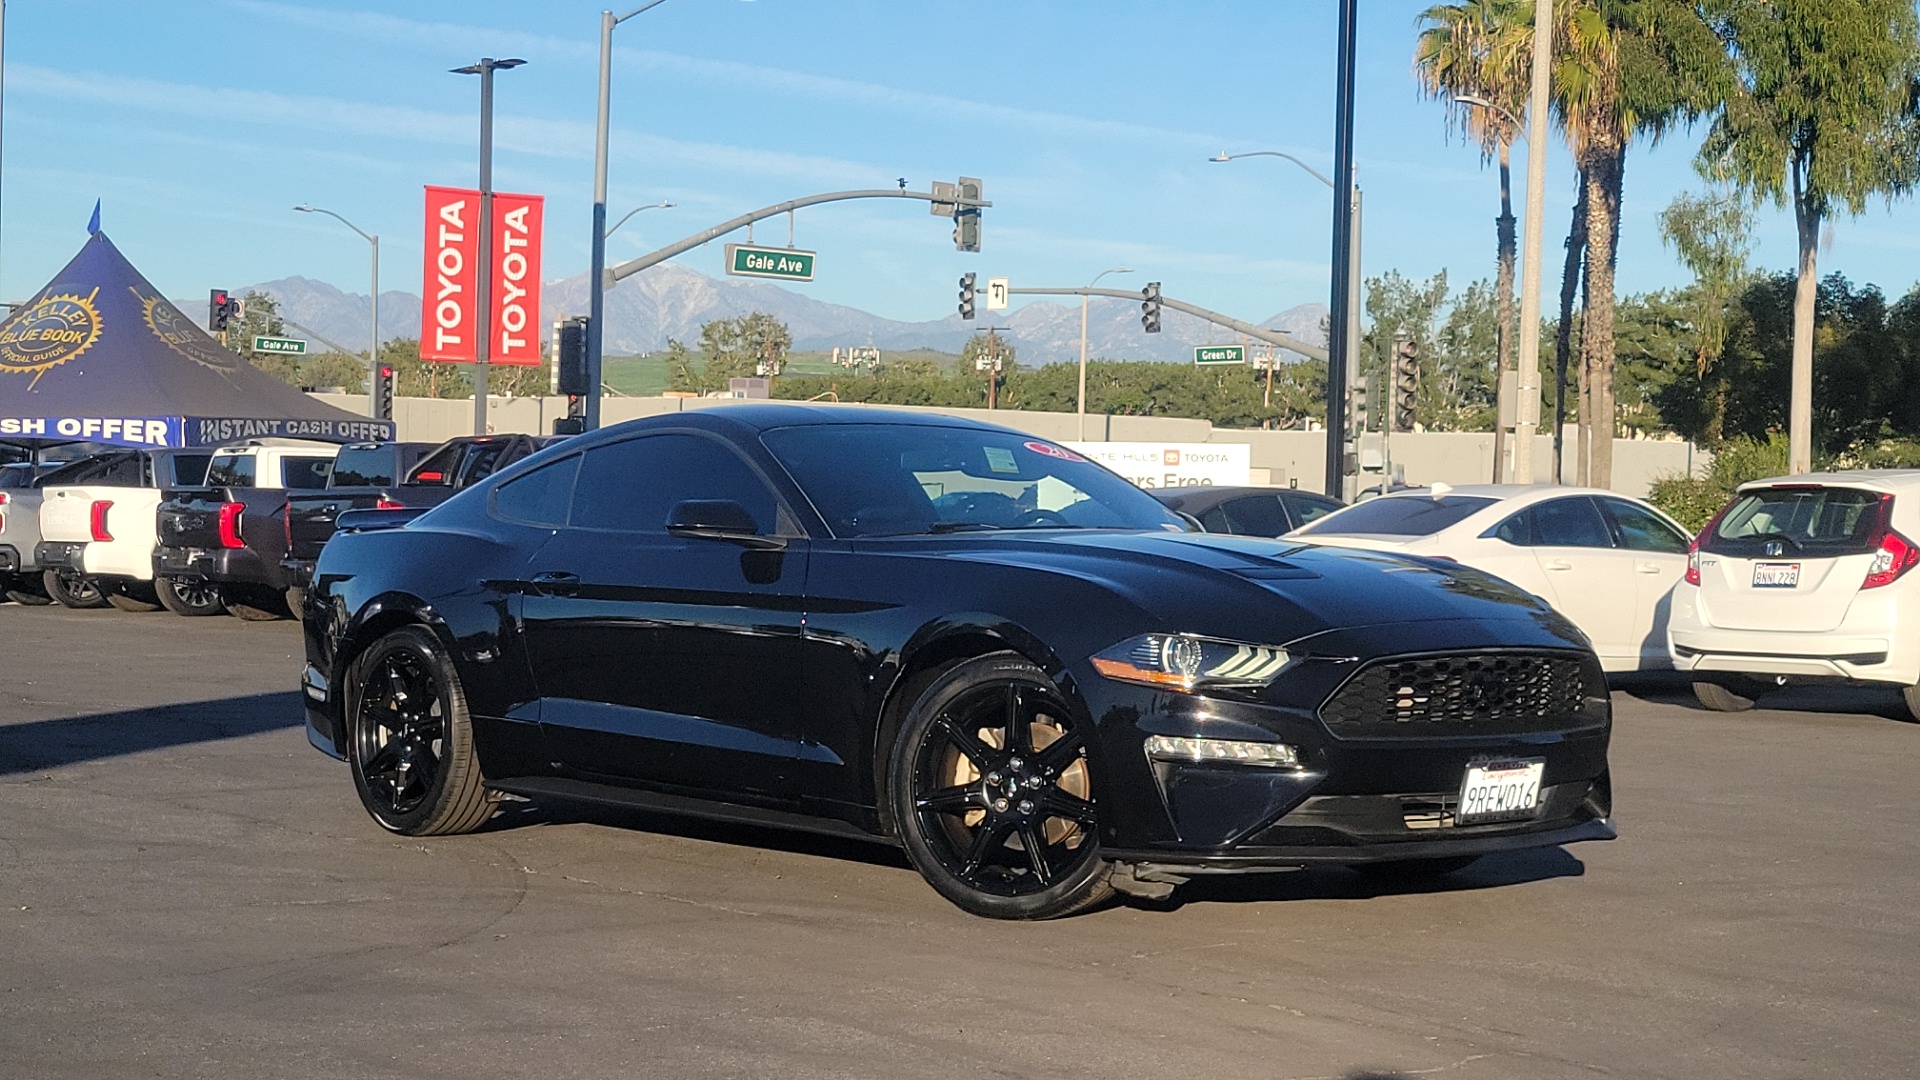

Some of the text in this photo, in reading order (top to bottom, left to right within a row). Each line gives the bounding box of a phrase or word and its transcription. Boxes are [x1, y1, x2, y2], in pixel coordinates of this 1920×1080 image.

[746, 253, 803, 273] Gale Ave
[436, 200, 465, 351] TOYOTA
[502, 206, 529, 354] TOYOTA
[22, 303, 89, 326] KELLEY
[0, 328, 88, 345] BLUE BOOK
[263, 340, 299, 351] Gale Ave
[33, 345, 68, 361] GUIDE
[1201, 349, 1238, 360] Green Dr
[0, 418, 168, 447] SH OFFER
[200, 419, 390, 444] INSTANT CASH OFFER
[1083, 452, 1229, 463] NTE HILLS TOYOTA
[1164, 473, 1213, 488] Free
[1465, 781, 1537, 814] 9REW016
